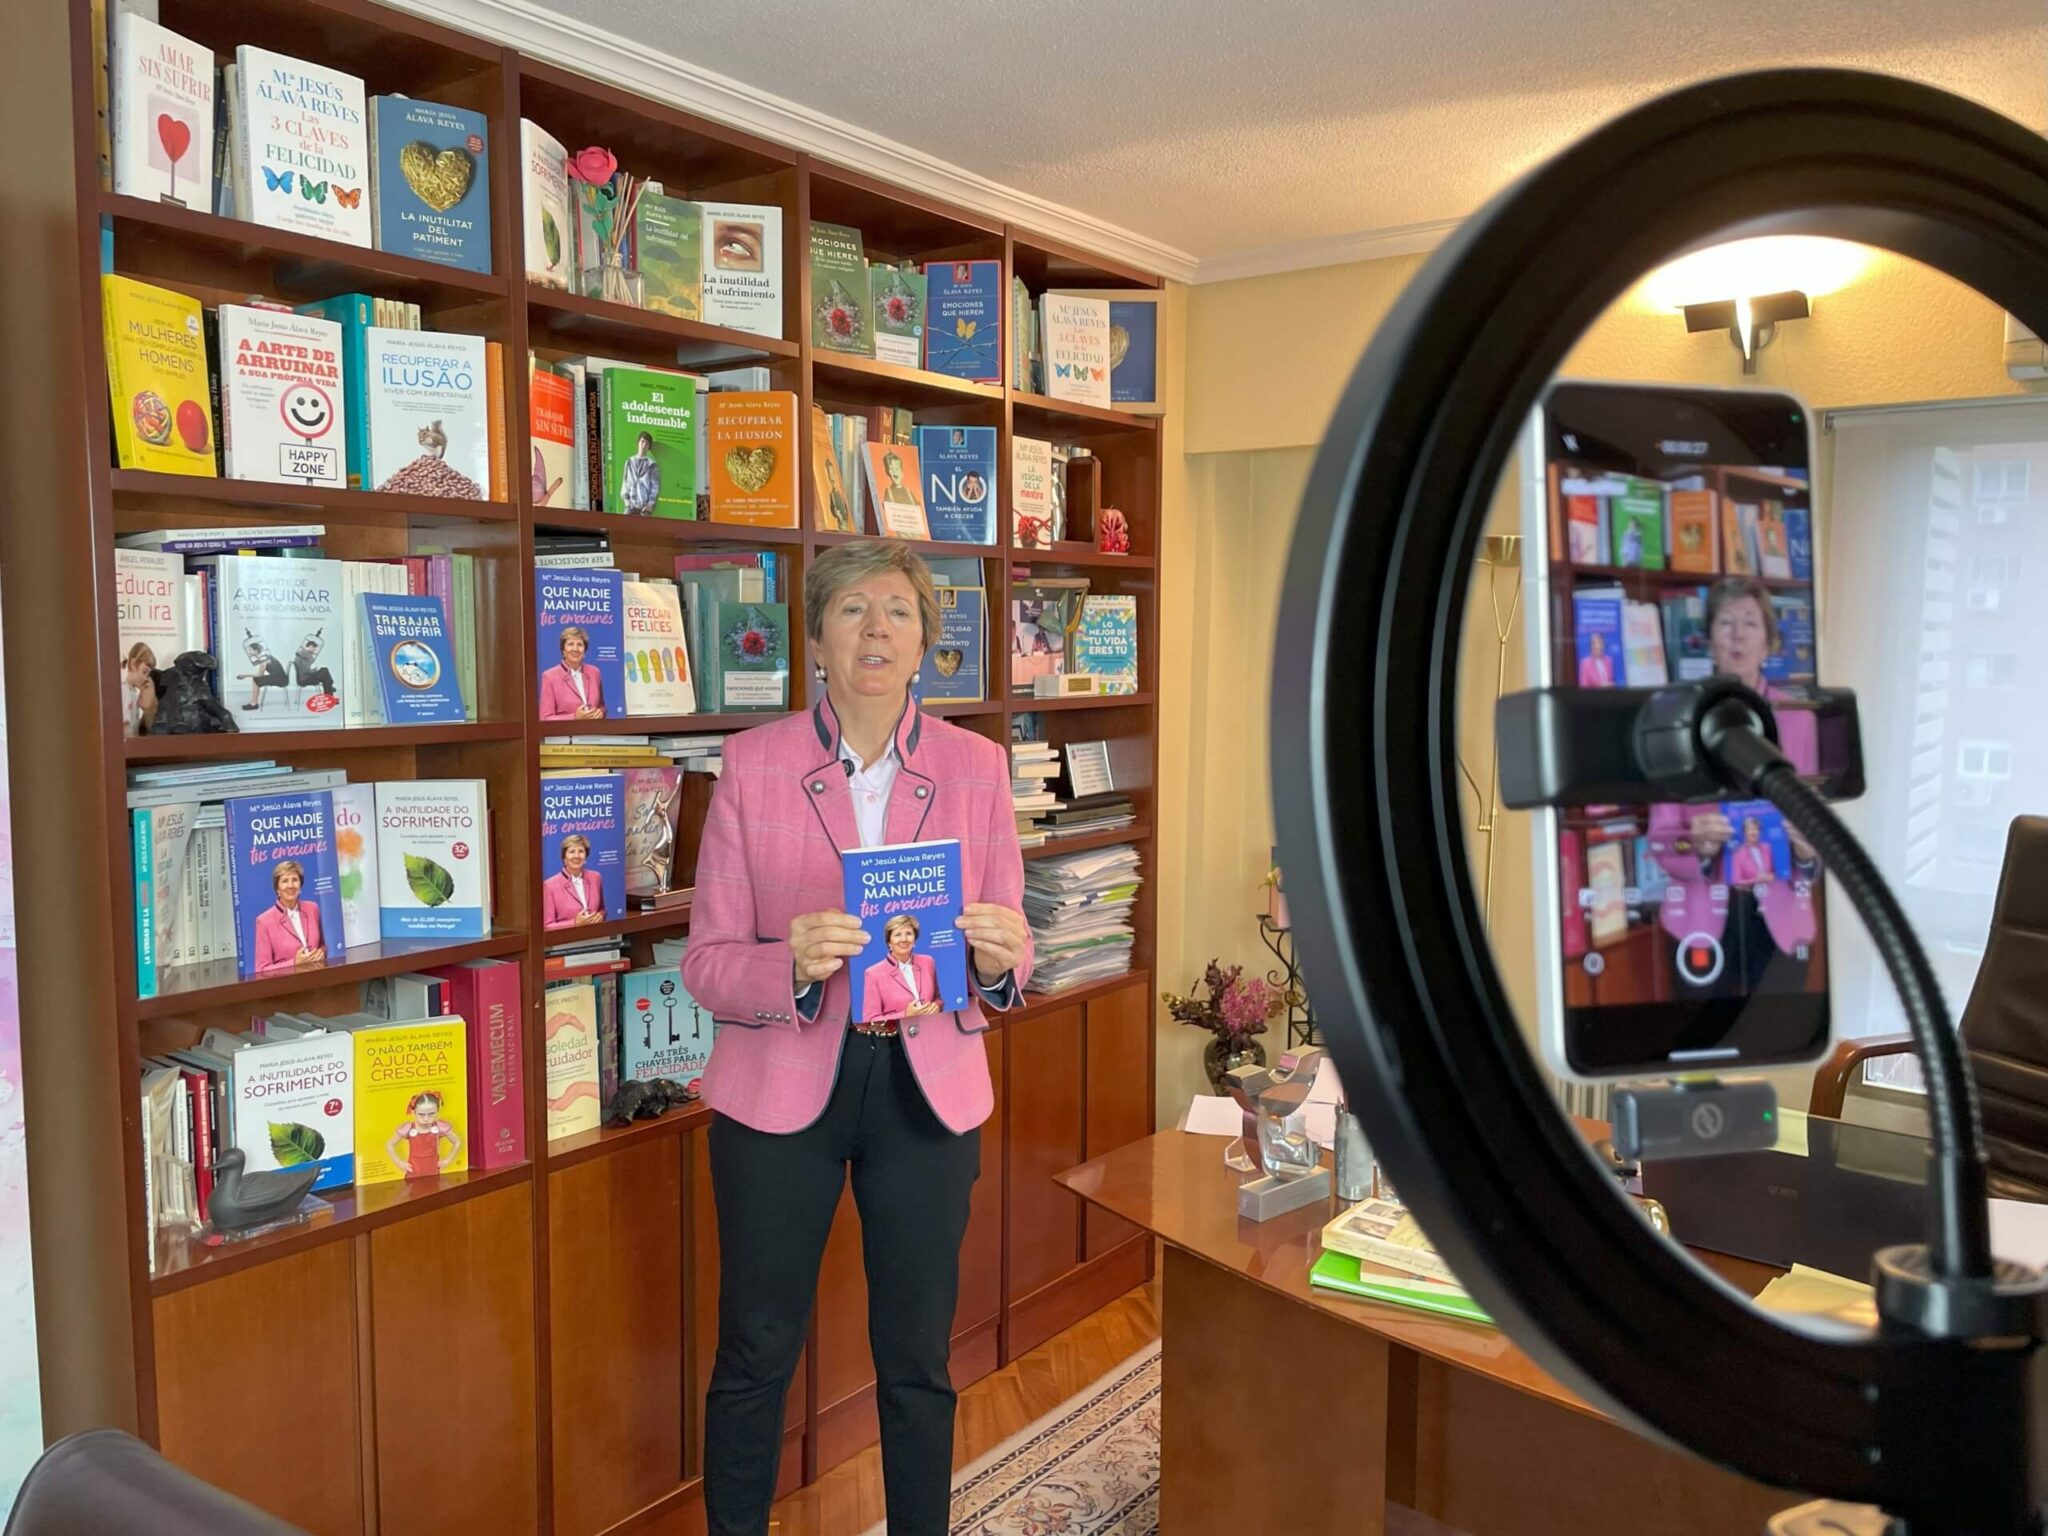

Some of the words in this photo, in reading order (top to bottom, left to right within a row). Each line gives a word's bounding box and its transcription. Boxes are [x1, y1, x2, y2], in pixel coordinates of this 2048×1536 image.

[159, 44, 194, 74] AMAR
[139, 56, 161, 79] SIN
[164, 66, 211, 102] SUFRIR
[297, 77, 343, 101] JESÚS
[256, 79, 307, 109] ÁLAVA
[312, 97, 359, 124] REYES
[301, 111, 320, 124] Las
[406, 113, 434, 125] ÁLAVA
[438, 118, 465, 130] REYES
[271, 116, 280, 130] 3
[285, 120, 349, 149] CLAVES
[300, 140, 312, 151] de
[315, 143, 324, 155] la
[266, 144, 356, 180] FELICIDAD
[401, 212, 415, 221] LA
[419, 213, 473, 230] INUTILITAT
[429, 225, 448, 235] DEL
[413, 232, 463, 247] PATIMENT
[811, 237, 856, 251] MOCIONES
[828, 250, 858, 261] HIEREN
[704, 274, 716, 283] La
[720, 275, 769, 287] inutilidad
[703, 286, 713, 294] el
[716, 287, 775, 299] sufrimiento
[1078, 317, 1106, 328] REYES
[129, 320, 197, 350] MULHERES
[239, 338, 252, 350] A
[256, 341, 307, 356] ARTE
[313, 349, 335, 363] DE
[1055, 349, 1104, 363] FELICIDAD
[139, 348, 193, 372] HOMENS
[236, 353, 339, 378] ARRUINAR
[382, 353, 459, 369] RECUPERAR
[463, 360, 472, 370] A
[249, 370, 268, 378] SUA
[271, 371, 313, 385] PRÓPRIA
[315, 378, 337, 388] VIDA
[382, 366, 472, 390] ILUSÃO
[424, 391, 473, 400] EXPECTATIVAS
[652, 393, 664, 403] El
[589, 392, 597, 428] INFANCIA
[622, 401, 691, 417] adolescente
[535, 418, 550, 432] SIN
[627, 412, 687, 429] indomable
[718, 416, 782, 425] RECUPERAR
[718, 431, 730, 440] LA
[735, 430, 783, 440] ILUSIÓN
[289, 450, 328, 463] HAPPY
[293, 463, 325, 475] ZONE
[1021, 473, 1043, 482] VERDAD
[931, 472, 987, 504] NO
[233, 589, 330, 603] ARRUINAR
[542, 586, 569, 598] QUE
[573, 588, 611, 598] NADIE
[118, 599, 141, 620] sin
[149, 600, 171, 620] ira
[544, 600, 610, 611] MANIPULE
[628, 608, 671, 619] CREZCAN
[374, 615, 439, 626] TRABAJAR
[540, 610, 555, 626] tus
[560, 613, 613, 624] emociones
[631, 620, 672, 632] FELICES
[376, 626, 396, 636] SIN
[400, 627, 441, 636] SUFRIR
[1089, 637, 1102, 645] TU
[1104, 637, 1127, 645] VIDA
[261, 802, 282, 812] Jesús
[544, 796, 572, 807] QUE
[575, 794, 613, 805] NADIE
[545, 807, 612, 820] MANIPULE
[251, 818, 279, 831] QUE
[284, 813, 323, 827] NADIE
[383, 816, 472, 828] SOFRIMENTO
[542, 822, 557, 836] tus
[561, 819, 615, 831] emociones
[253, 828, 324, 845] MANIPULE
[250, 847, 268, 865] tus
[272, 842, 327, 859] emociones
[874, 856, 897, 866] Jesús
[899, 855, 920, 863] Álava
[922, 853, 945, 861] Reyes
[862, 871, 895, 887] QUE
[900, 866, 946, 881] NADIE
[864, 880, 945, 899] MANIPULE
[861, 900, 879, 918] tus
[884, 894, 949, 914] emociones
[379, 1045, 403, 1055] NÃO
[408, 1041, 453, 1051] TAMBÉM
[489, 1003, 506, 1105] VADEMECUM
[654, 1051, 664, 1059] AS
[667, 1046, 688, 1057] TRÊS
[372, 1053, 430, 1068] AJUDA
[436, 1051, 448, 1062] A
[548, 1048, 592, 1067] uidador
[636, 1059, 671, 1068] CHAVES
[260, 1065, 323, 1081] INUTILIDADE
[328, 1061, 344, 1071] DO
[371, 1063, 448, 1082] CRESCER
[636, 1062, 705, 1079] FELICIDADE
[244, 1071, 347, 1099] SOFRIMENTO
